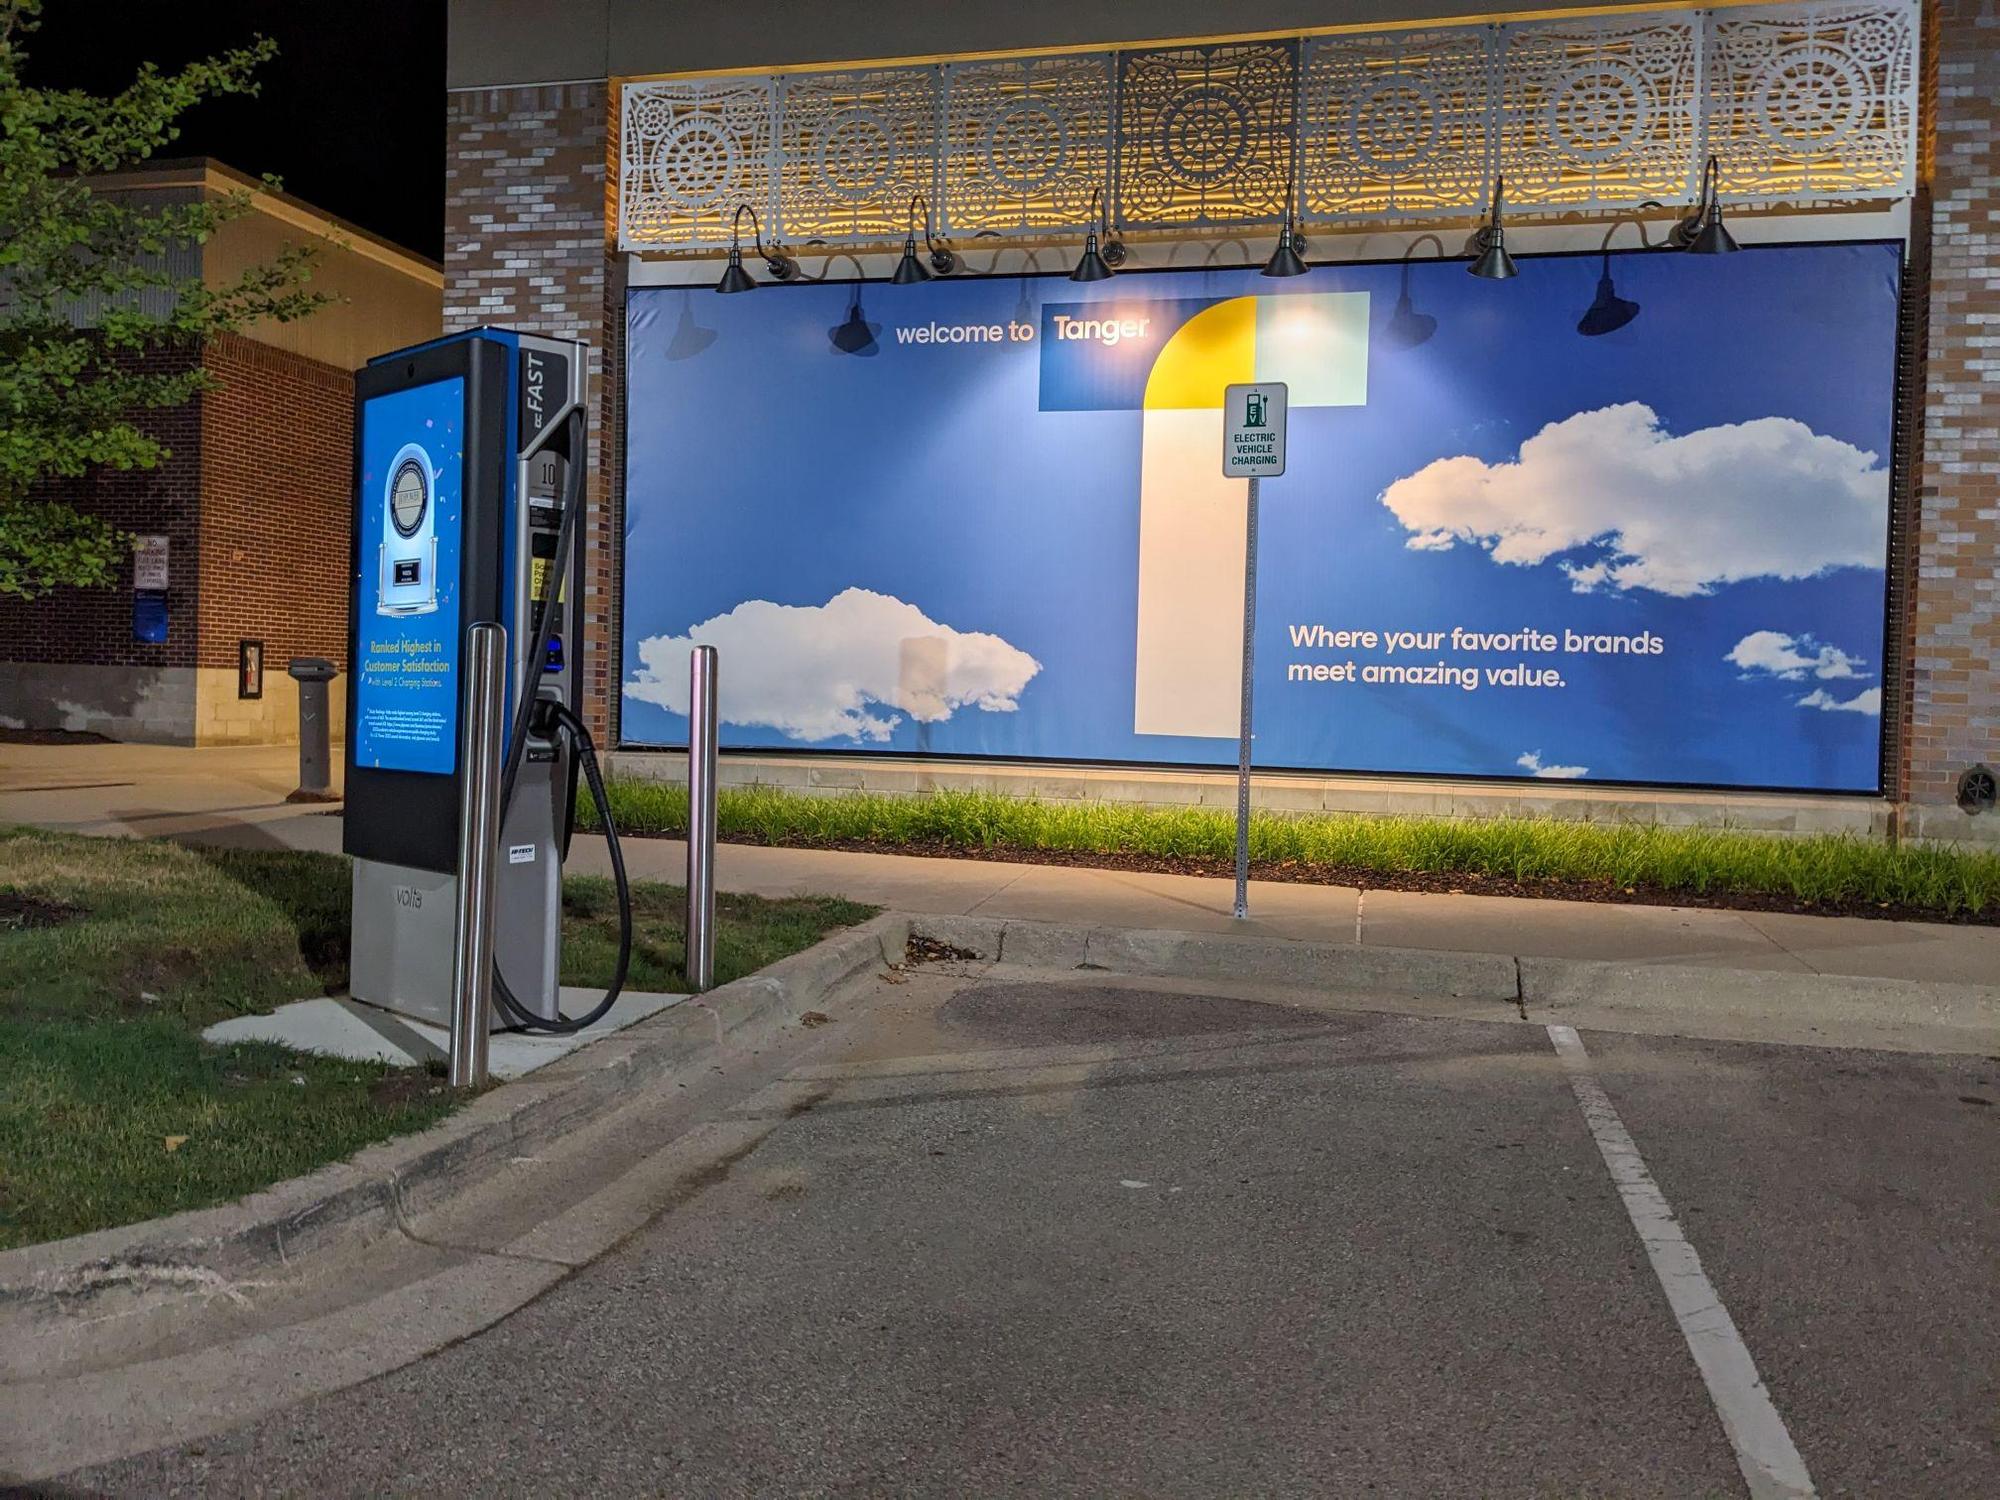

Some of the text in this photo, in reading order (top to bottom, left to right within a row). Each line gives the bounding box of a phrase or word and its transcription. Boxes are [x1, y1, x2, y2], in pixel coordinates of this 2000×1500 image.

[896, 320, 1034, 344] welcome to
[1053, 315, 1150, 346] Tanger
[527, 352, 544, 411] FAST
[1234, 432, 1276, 443] ELECTRIC
[1236, 444, 1273, 454] VEHICLE
[1231, 455, 1278, 466] CHARGING
[541, 463, 556, 485] 10
[370, 639, 442, 656] Ranked Highest in
[1289, 624, 1664, 655] Where your favorite brands
[364, 657, 450, 673] Customer Satisfaction
[398, 677, 421, 690] Charging
[1287, 661, 1567, 690] meet amazing value.
